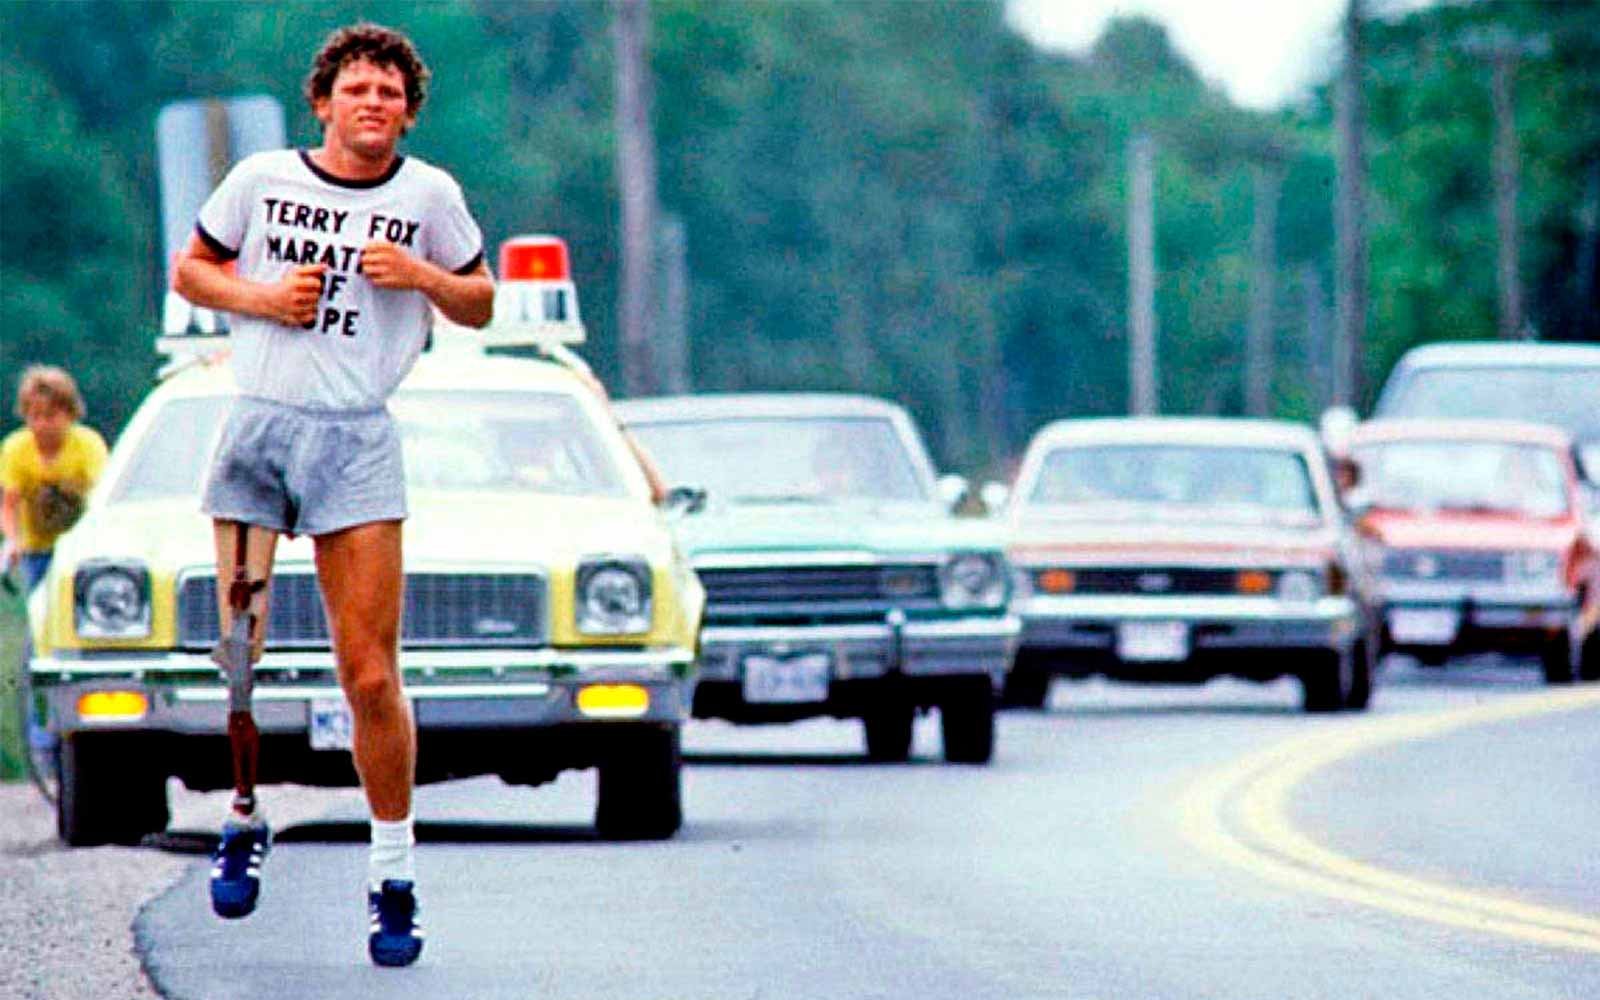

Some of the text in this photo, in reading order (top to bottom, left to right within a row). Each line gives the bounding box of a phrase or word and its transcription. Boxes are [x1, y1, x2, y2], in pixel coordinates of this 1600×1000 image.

[264, 199, 419, 246] TERRY FOX
[303, 308, 360, 336] PE
